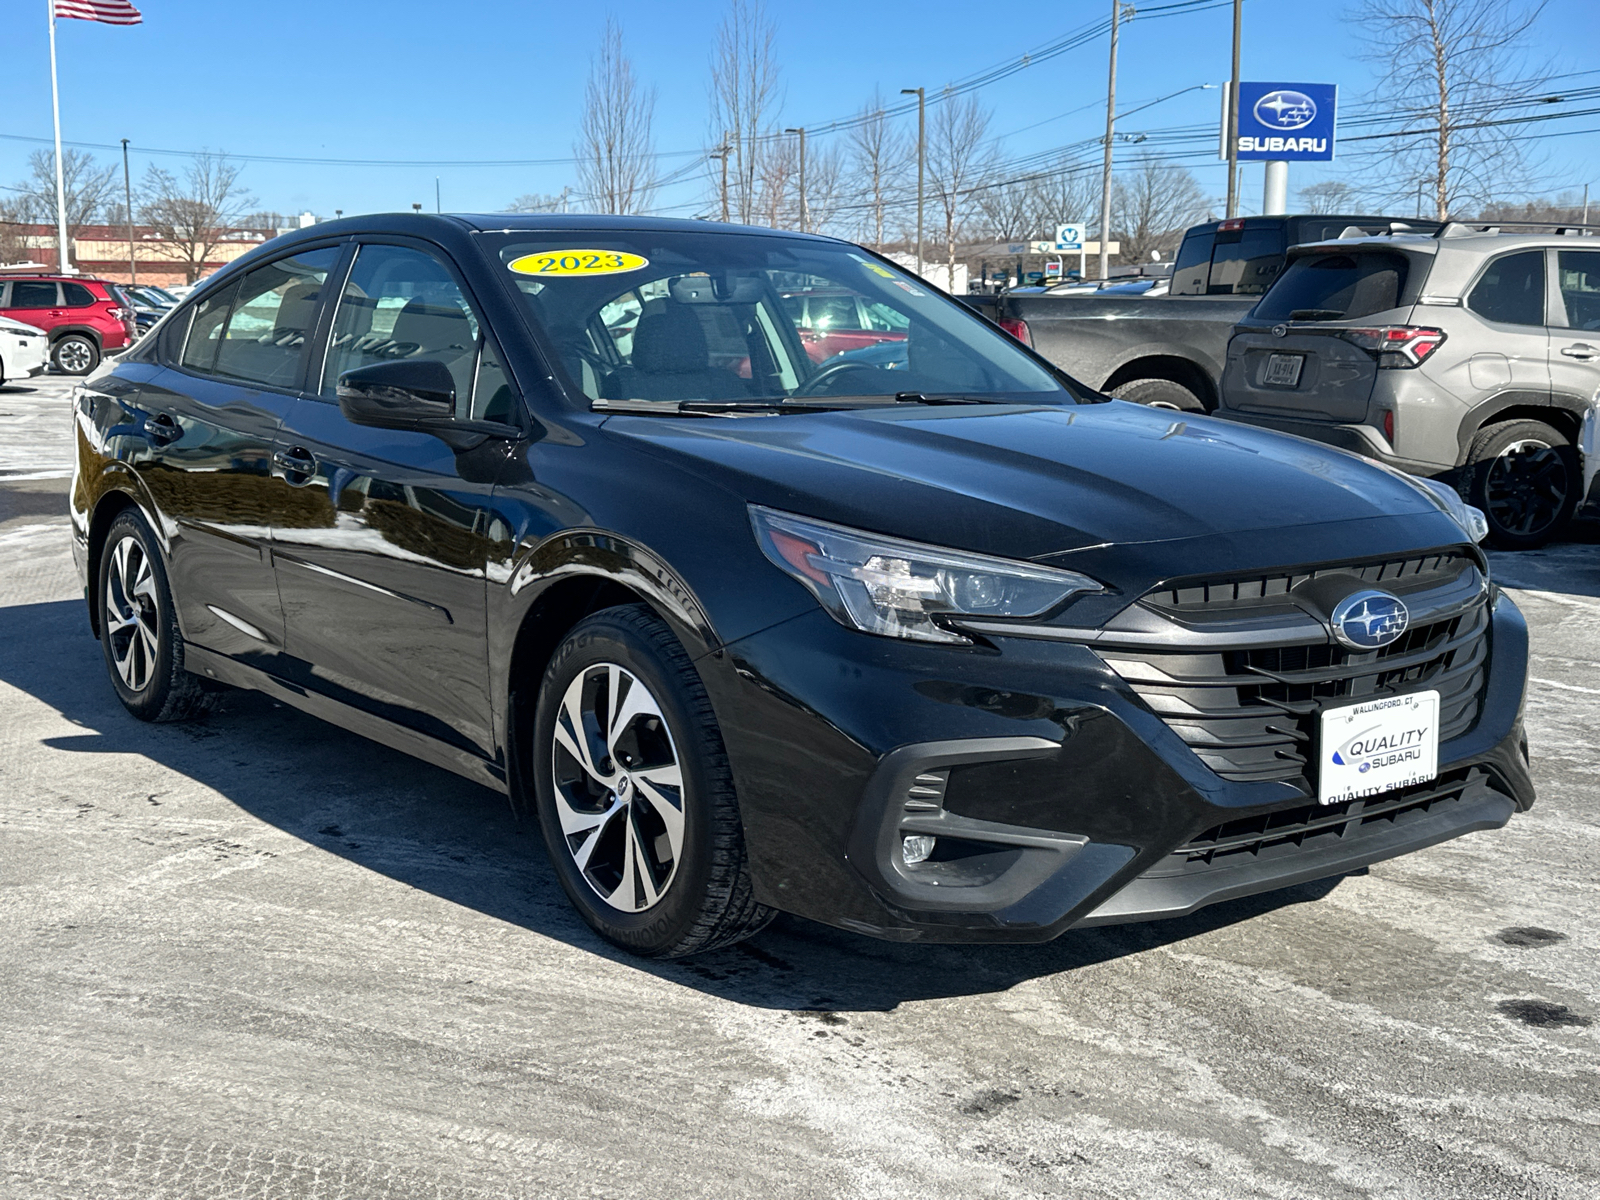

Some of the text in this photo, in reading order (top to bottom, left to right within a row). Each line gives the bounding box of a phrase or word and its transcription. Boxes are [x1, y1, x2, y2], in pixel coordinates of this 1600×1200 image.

[1238, 137, 1326, 152] SUBARU
[537, 254, 625, 273] 2023
[1404, 696, 1414, 705] CT
[1350, 727, 1428, 757] QUALITY
[1372, 749, 1421, 769] SUBARU
[1327, 772, 1434, 805] QUALITY SUBARU
